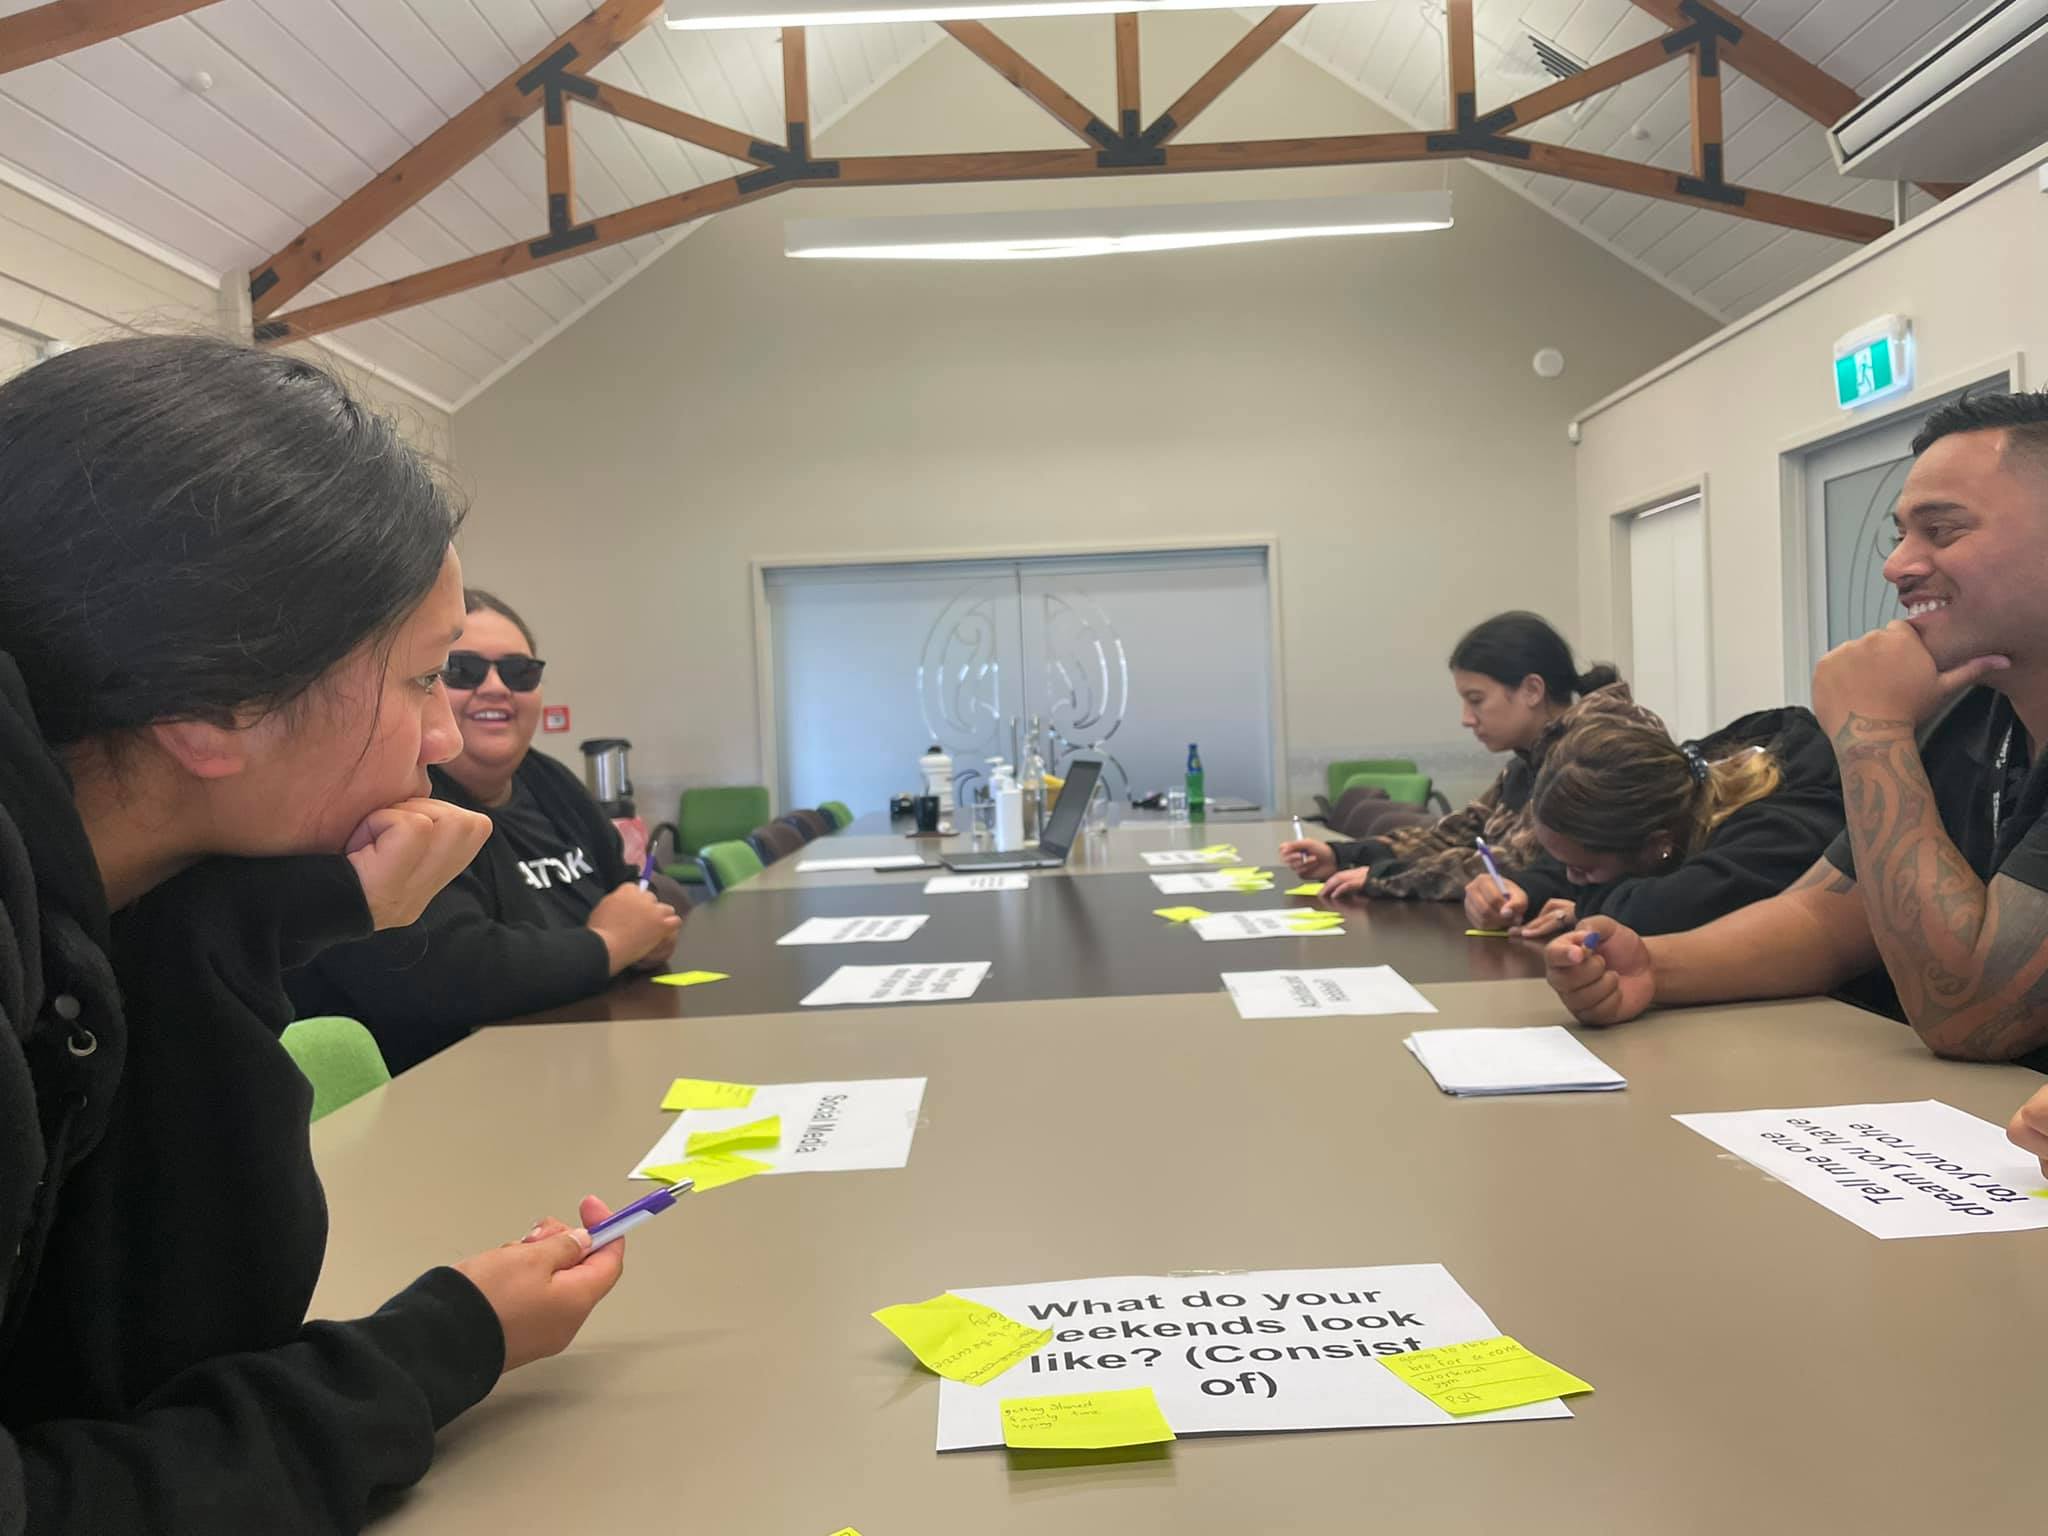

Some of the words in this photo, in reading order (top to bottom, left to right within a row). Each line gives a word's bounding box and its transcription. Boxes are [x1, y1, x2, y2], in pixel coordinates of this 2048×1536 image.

[810, 1094, 848, 1122] Social
[794, 1124, 837, 1154] Media
[1760, 1132, 1813, 1153] one
[1786, 1118, 1852, 1145] have
[1848, 1123, 1915, 1149] rohe
[1805, 1156, 1856, 1175] me
[1840, 1147, 1912, 1170] you
[1903, 1152, 1992, 1180] your
[1835, 1179, 1905, 1204] Tell
[1893, 1173, 1995, 1216] dream
[1969, 1183, 2030, 1203] for
[1028, 1294, 1166, 1321] What
[1182, 1291, 1247, 1308] do
[1261, 1290, 1382, 1311] your
[1056, 1316, 1287, 1343] eekends
[1302, 1310, 1426, 1332] look
[1031, 1348, 1163, 1374] like?
[1185, 1337, 1422, 1369] (Consist
[1200, 1371, 1278, 1399] of)
